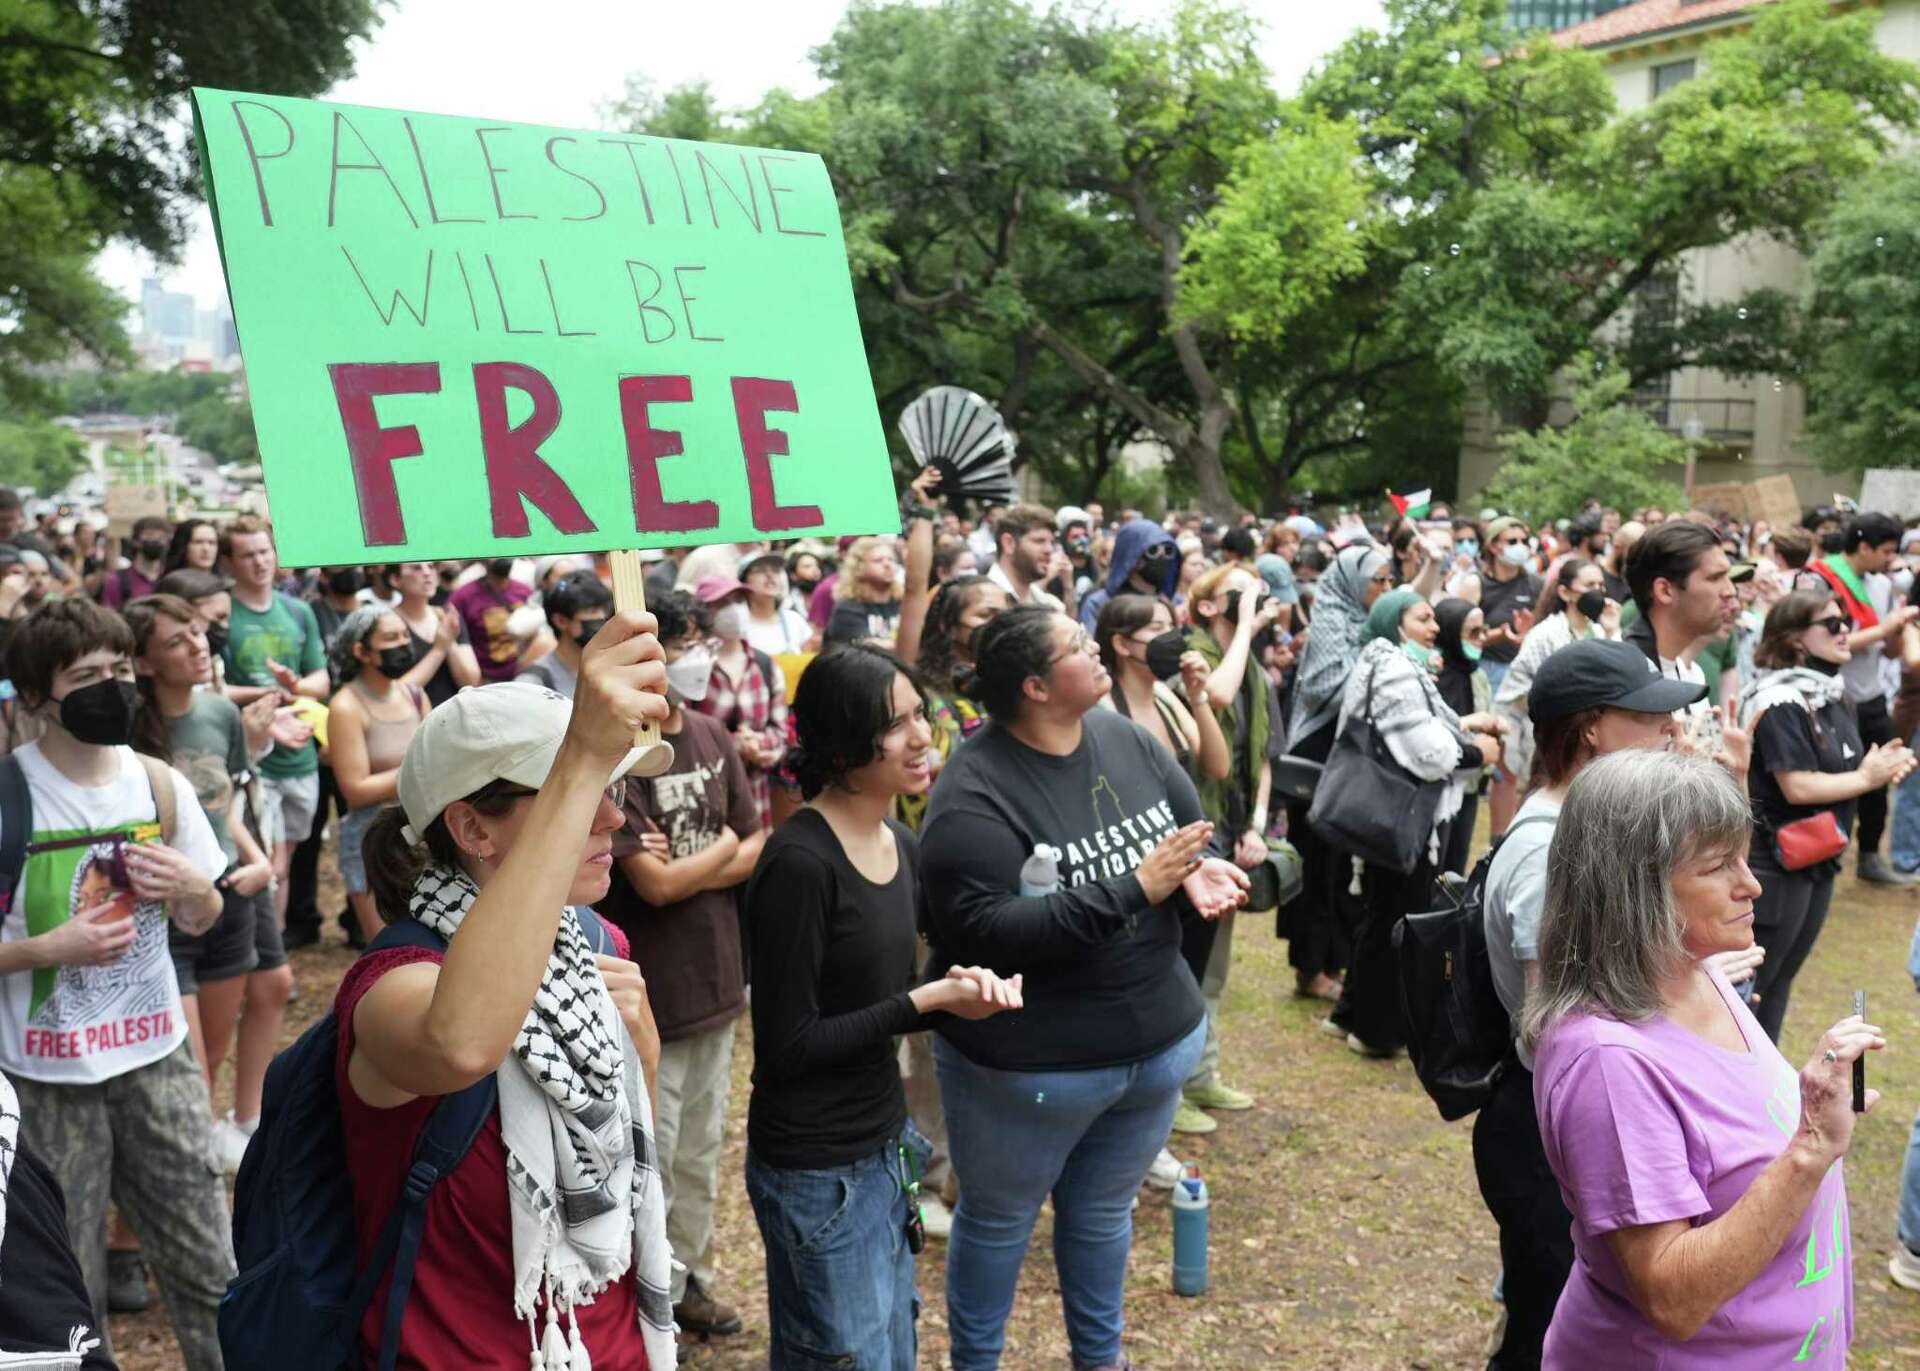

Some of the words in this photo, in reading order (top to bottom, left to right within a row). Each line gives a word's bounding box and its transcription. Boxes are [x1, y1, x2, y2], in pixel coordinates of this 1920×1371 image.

[231, 100, 827, 237] PALESTINE
[341, 245, 597, 337] WILL
[625, 259, 725, 344] BE
[326, 360, 825, 547] FREE
[1050, 799, 1176, 867] PALESTINE
[25, 1027, 82, 1059] FREE
